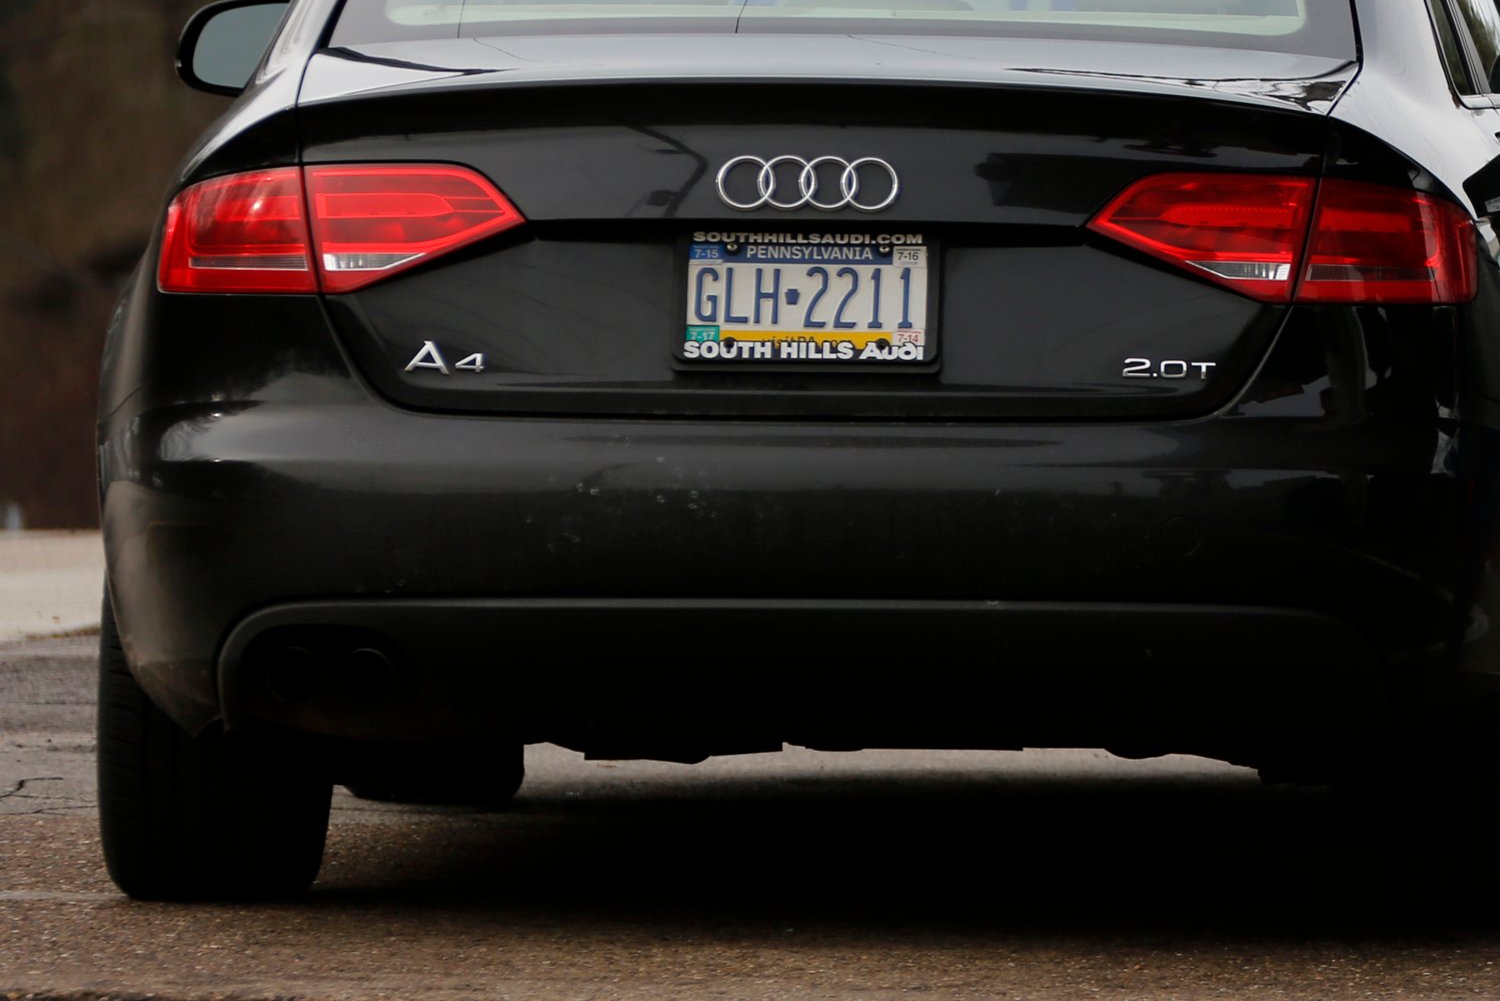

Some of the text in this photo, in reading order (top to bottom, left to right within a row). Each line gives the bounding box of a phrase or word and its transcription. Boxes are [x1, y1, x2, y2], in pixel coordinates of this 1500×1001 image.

[693, 231, 923, 244] SOUTHHILLSAUDI.COM
[695, 248, 719, 259] 7-15
[746, 245, 873, 260] PENNSYLVANIA
[898, 251, 919, 261] 7-16
[897, 333, 919, 343] 7-14
[683, 340, 772, 359] SOUTH
[780, 341, 854, 359] HILLS
[403, 340, 484, 375] A4
[1122, 358, 1217, 379] 2.0T
